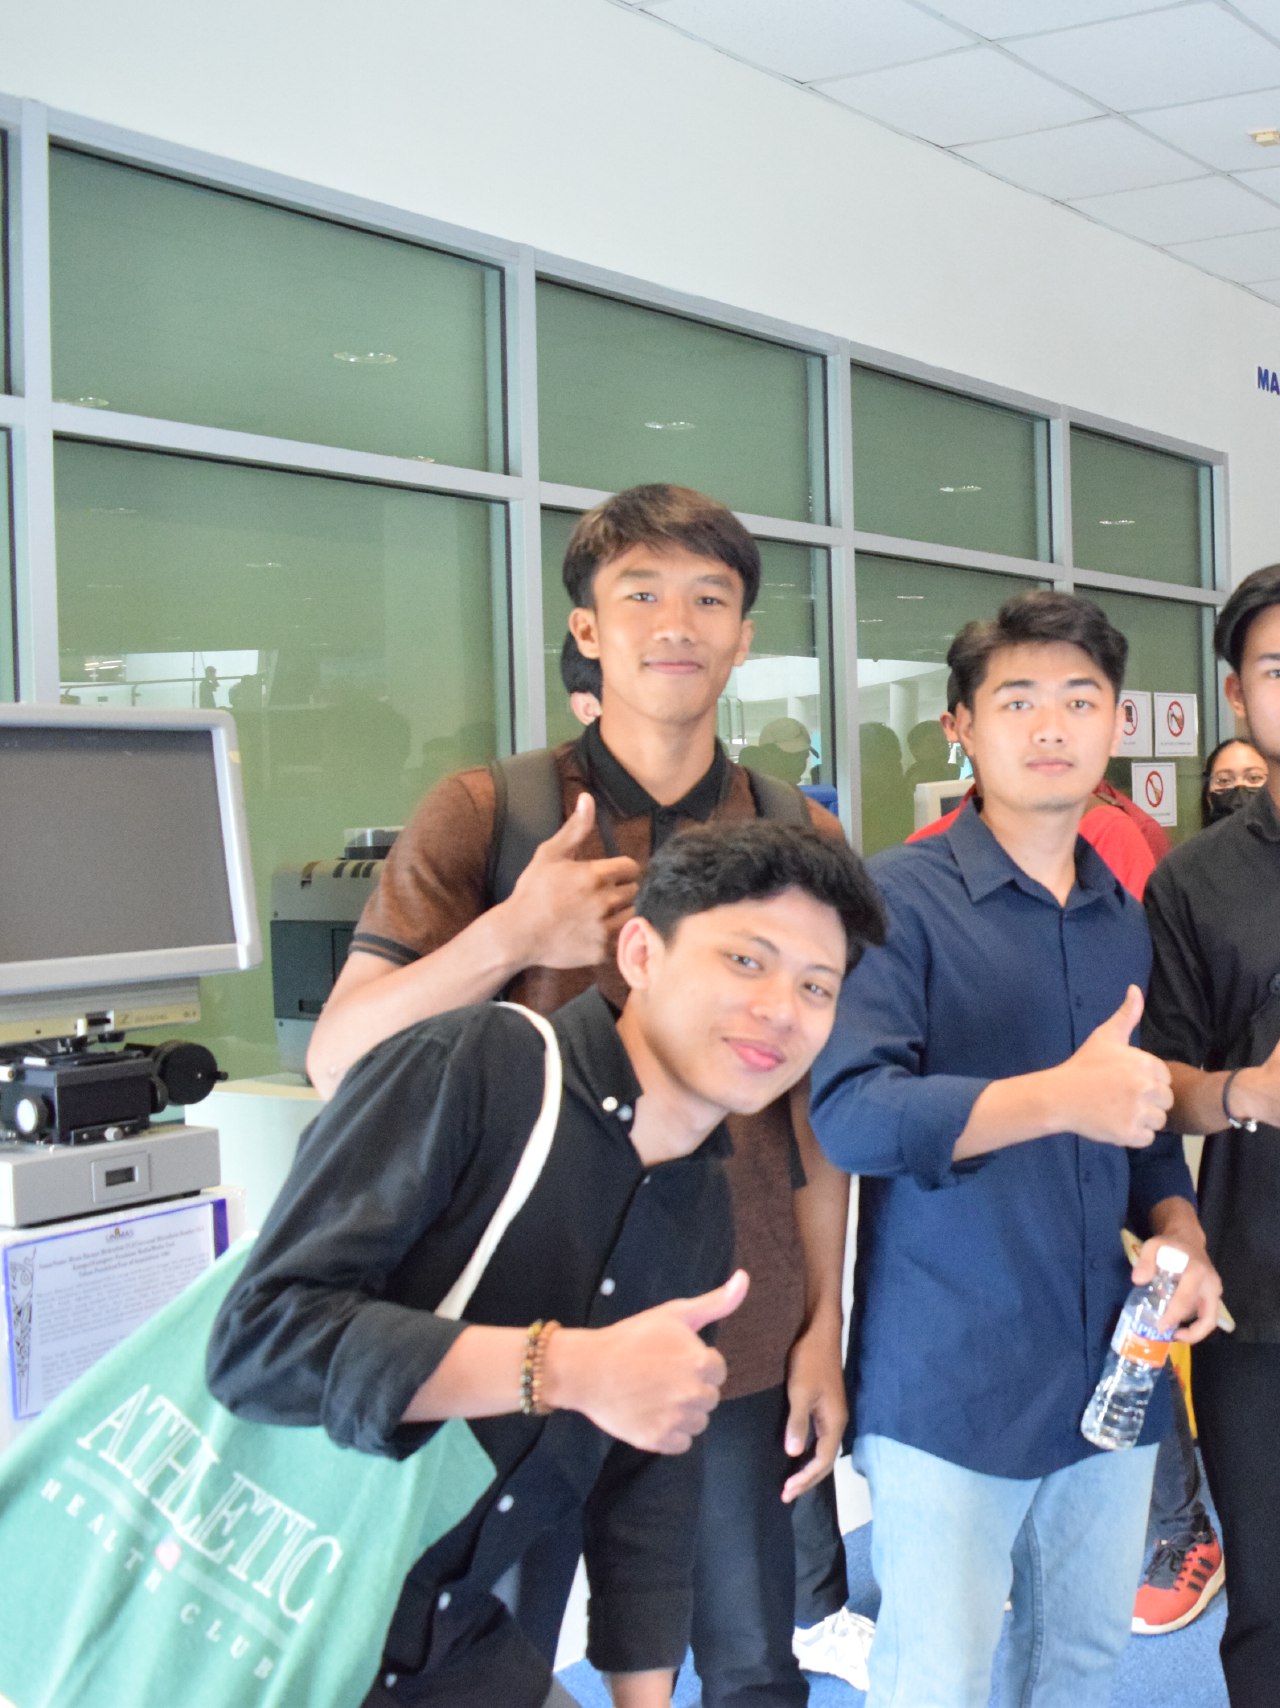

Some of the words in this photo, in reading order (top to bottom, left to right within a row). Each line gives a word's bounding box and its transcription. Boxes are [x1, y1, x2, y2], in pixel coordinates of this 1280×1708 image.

[40, 1478, 162, 1593] HEALTH
[180, 1602, 274, 1680] CLUB
[76, 1384, 343, 1624] ATHLETIC
